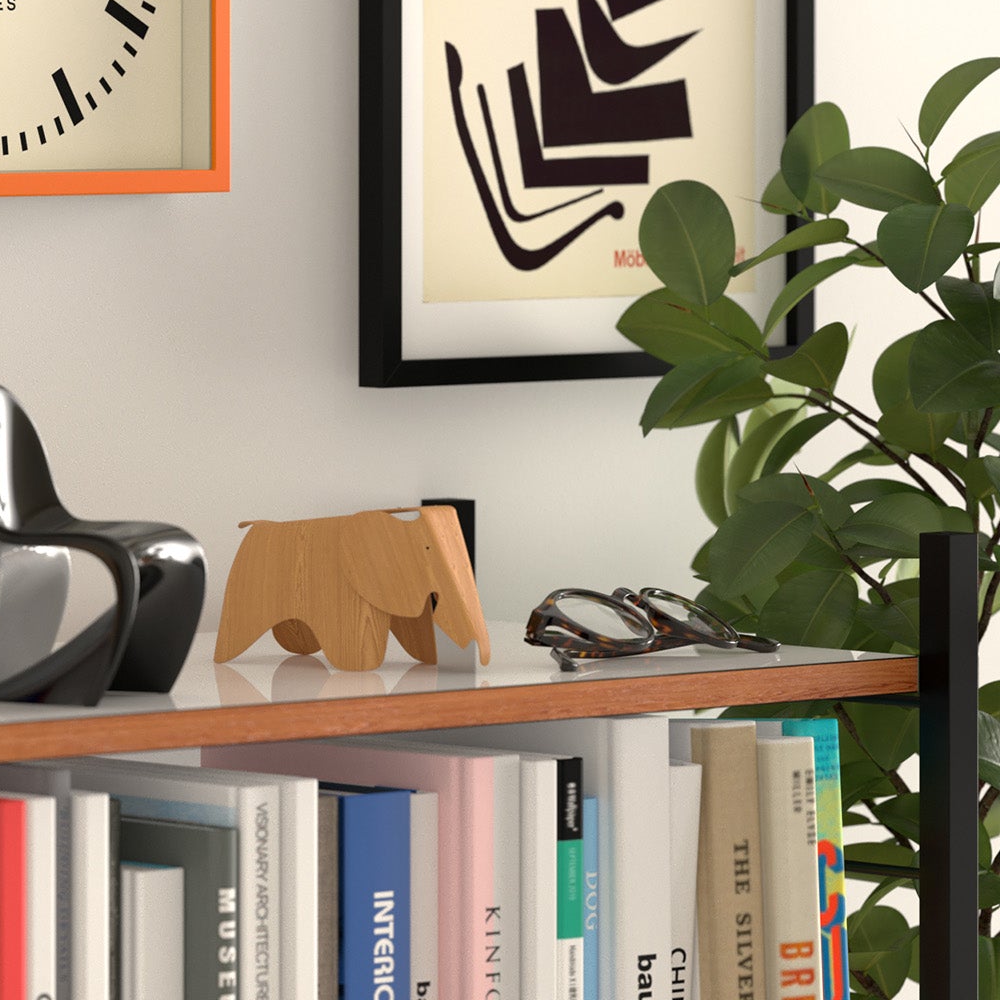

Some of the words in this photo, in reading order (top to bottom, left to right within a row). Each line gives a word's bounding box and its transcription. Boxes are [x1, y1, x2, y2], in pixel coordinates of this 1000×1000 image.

[255, 802, 270, 882] VISIONARY
[733, 838, 750, 895] THE
[585, 871, 599, 931] DOG
[670, 947, 687, 1000] CHI
